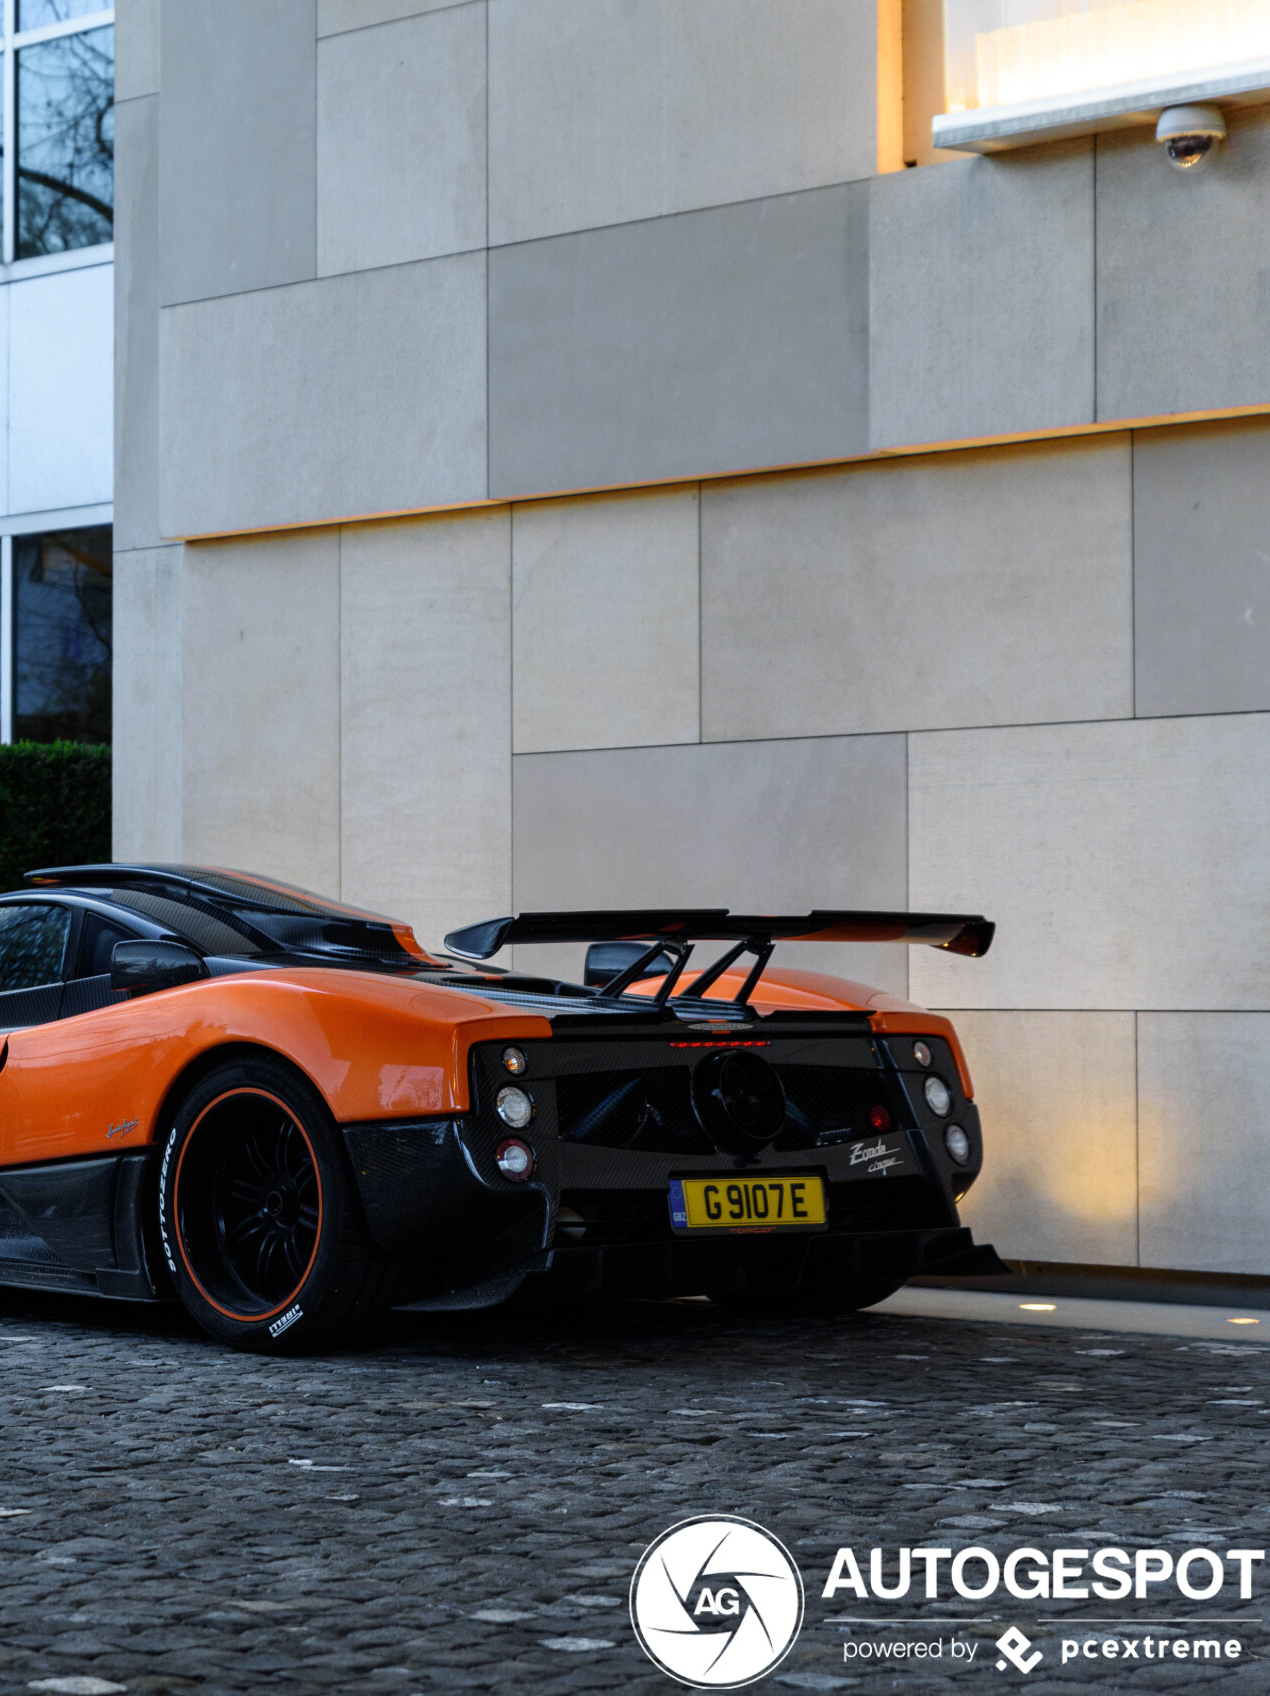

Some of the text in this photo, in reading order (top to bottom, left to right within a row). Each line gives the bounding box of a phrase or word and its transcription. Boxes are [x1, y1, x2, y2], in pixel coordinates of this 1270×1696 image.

[158, 1127, 177, 1273] SOTTOZERO
[673, 1211, 687, 1222] GBZ
[268, 1303, 304, 1338] PIRELLI
